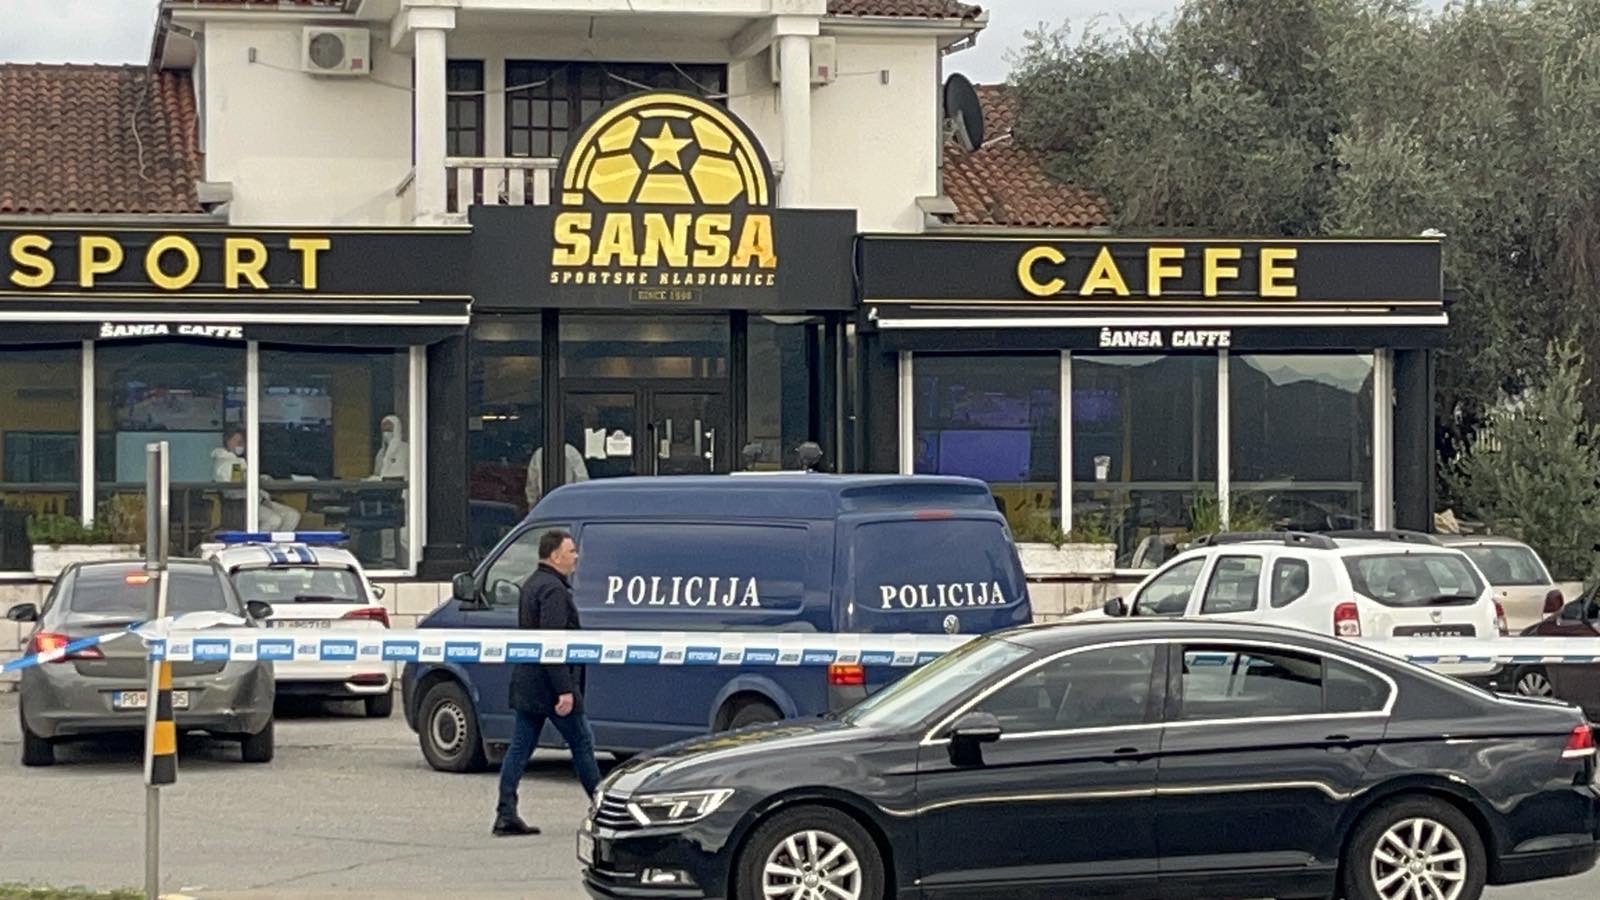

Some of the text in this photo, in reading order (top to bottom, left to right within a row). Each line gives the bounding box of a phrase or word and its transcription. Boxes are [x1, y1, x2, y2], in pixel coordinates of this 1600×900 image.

[9, 233, 332, 291] SPORT
[1017, 245, 1299, 298] CAFFE
[549, 271, 776, 286] SPORTSKE KLADIONICE
[100, 322, 244, 339] ŠANSA CAFFE
[1099, 327, 1231, 348] ŠANSA CAFFE
[606, 575, 761, 608] POLICIJA
[879, 581, 1007, 609] POLICIJA
